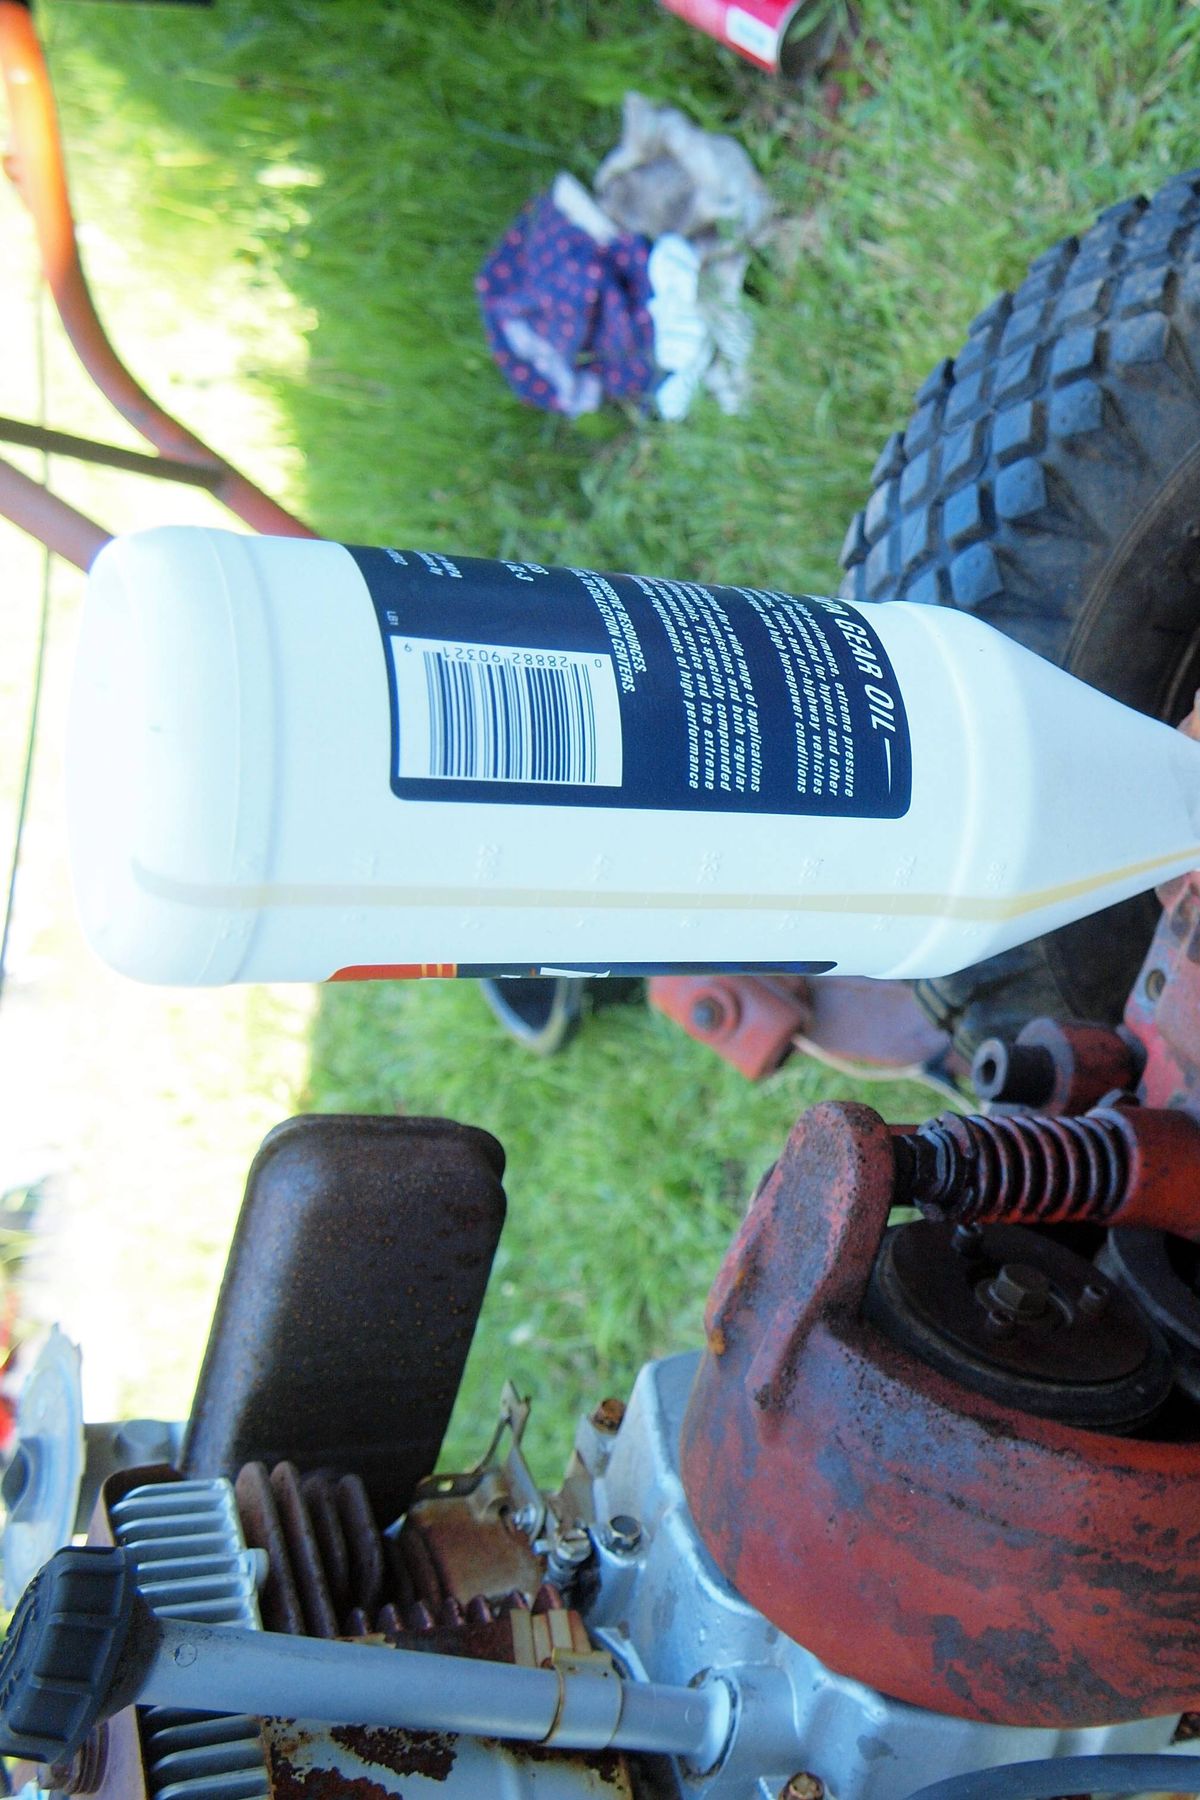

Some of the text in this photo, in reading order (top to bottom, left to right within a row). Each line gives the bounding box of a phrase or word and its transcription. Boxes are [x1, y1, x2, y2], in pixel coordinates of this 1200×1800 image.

[586, 586, 623, 638] COLLECTION
[611, 638, 636, 694] CENTERS.
[649, 596, 684, 654] requirements
[694, 625, 708, 635] It
[698, 634, 711, 645] is
[699, 608, 735, 675] transmissions
[716, 612, 731, 626] for
[723, 625, 734, 633] a
[780, 603, 823, 663] Recommended
[793, 602, 840, 677] high-performance,
[614, 610, 647, 674] RESOURCES.
[676, 656, 691, 670] of
[681, 629, 704, 670] service
[727, 633, 745, 657] wide
[787, 636, 806, 657] and
[679, 670, 696, 699] high
[695, 673, 712, 699] and
[702, 646, 725, 701] specially
[726, 677, 743, 703] and
[736, 657, 753, 691] range
[796, 657, 821, 731] off-highway
[813, 663, 827, 682] for
[834, 618, 884, 679] GEAR
[864, 684, 896, 733] OIL
[700, 701, 714, 725] the
[731, 704, 746, 735] both
[745, 693, 759, 709] of
[768, 629, 787, 651] high
[778, 651, 804, 720] horsepower
[794, 721, 809, 794] conditions
[818, 682, 838, 727] hypoid
[834, 682, 852, 733] extreme
[682, 699, 700, 789] performance
[703, 729, 716, 790] extreme
[716, 702, 732, 792] compounded
[745, 708, 763, 793] applications
[827, 728, 841, 756] and
[733, 738, 747, 793] regular
[812, 735, 825, 795] vehicles
[828, 758, 840, 796] other
[841, 735, 855, 798] pressure
